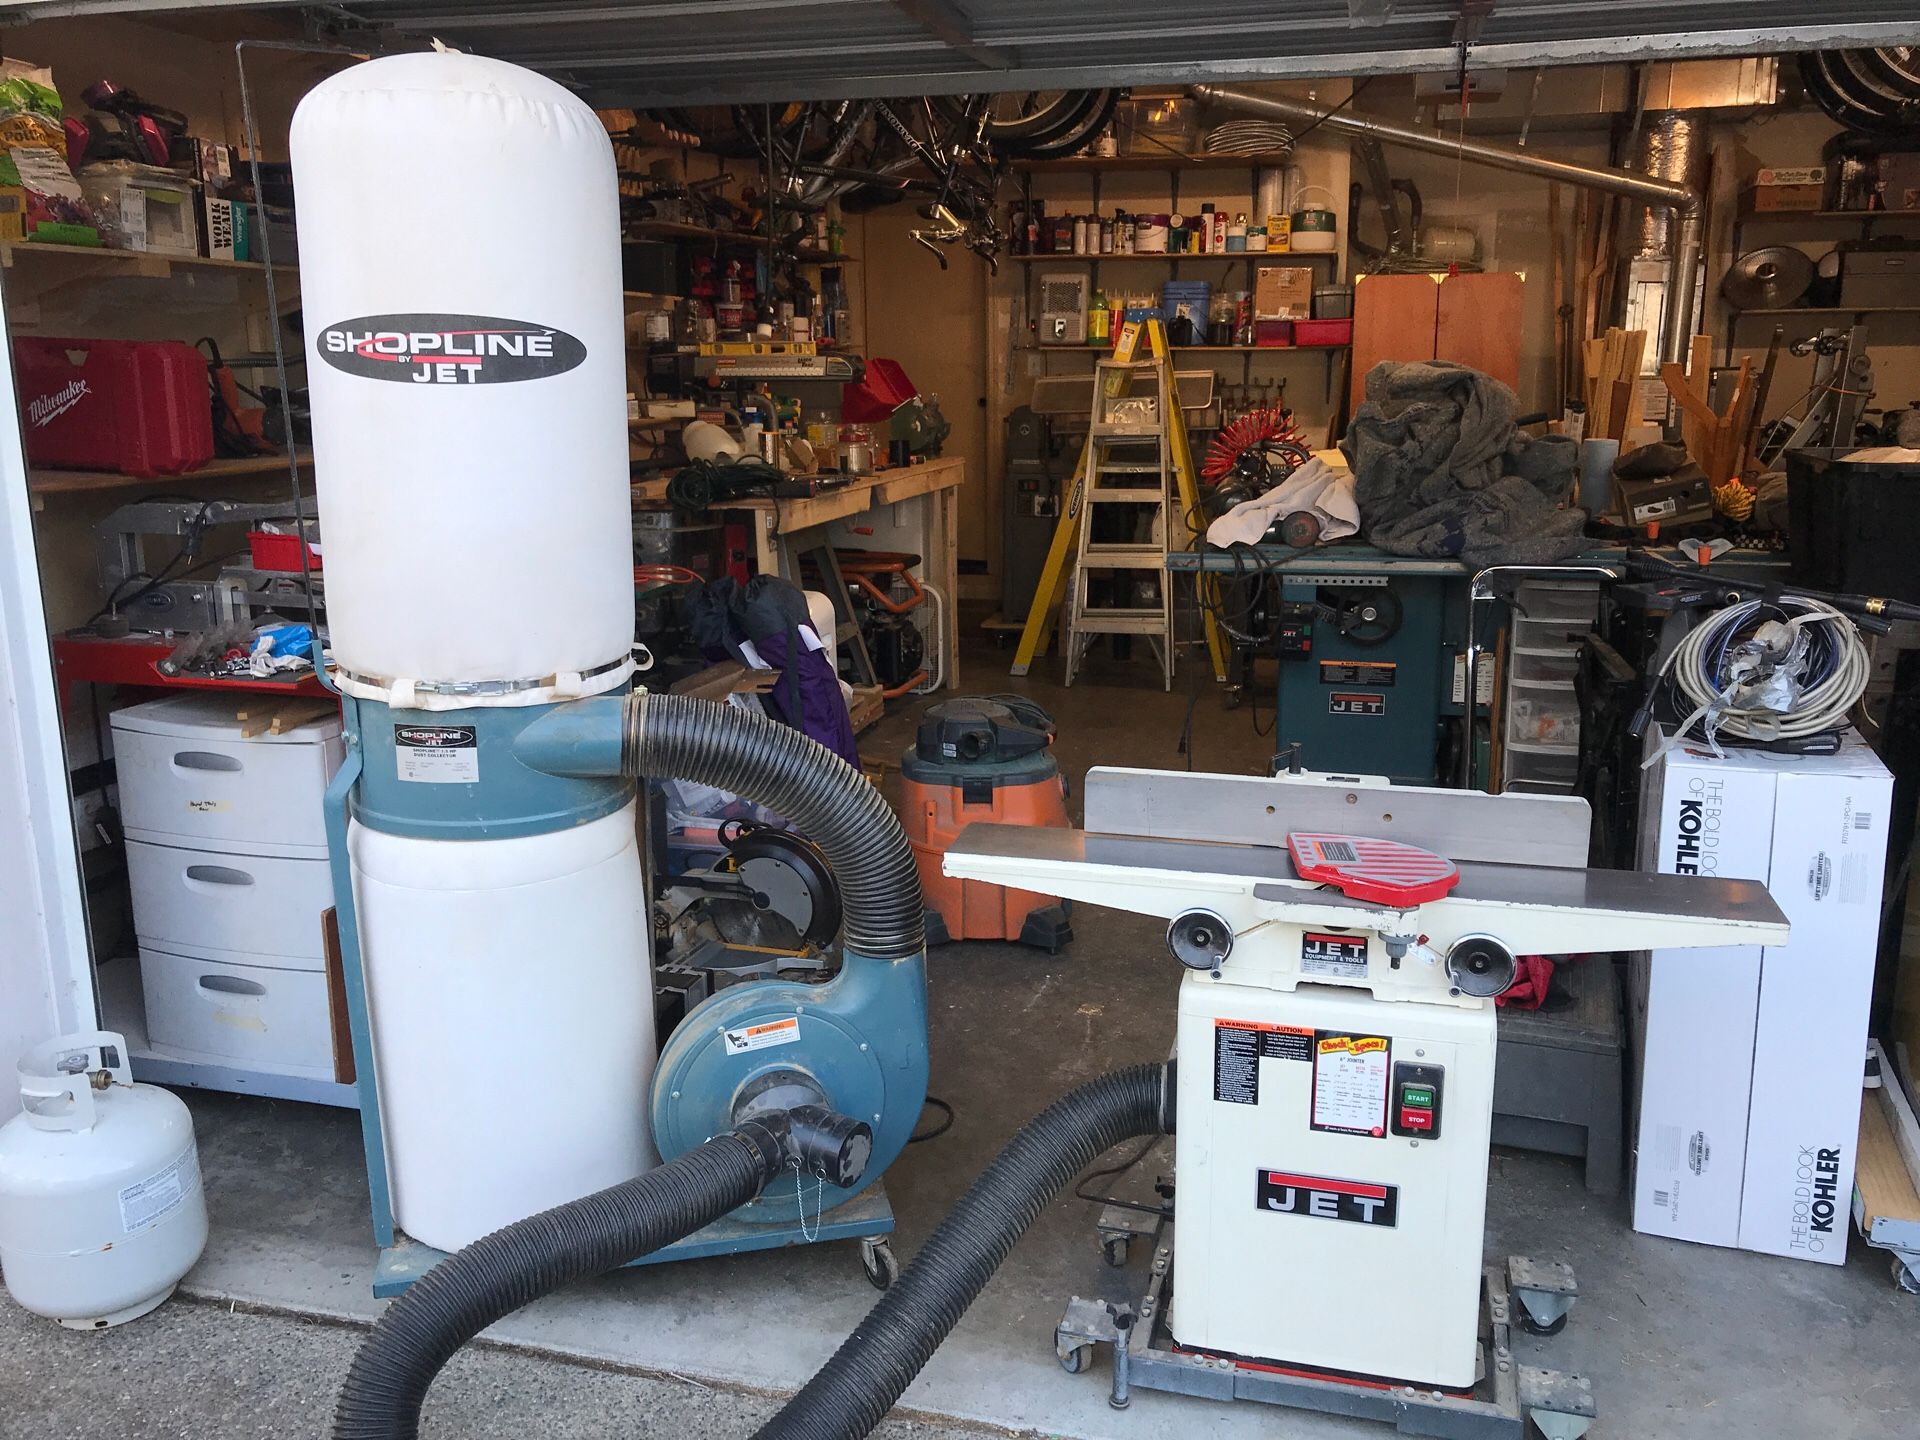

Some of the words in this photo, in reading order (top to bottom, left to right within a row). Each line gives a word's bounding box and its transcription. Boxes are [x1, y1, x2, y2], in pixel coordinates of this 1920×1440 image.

[211, 202, 223, 248] WORK
[221, 205, 232, 248] WEAR
[236, 207, 245, 243] Wrangler
[326, 330, 553, 357] SHOPLINE
[398, 355, 411, 363] BY
[412, 363, 482, 383] JET
[28, 379, 92, 423] Milwaukee
[1333, 701, 1381, 712] JET
[401, 731, 461, 739] SHOPLINE
[1688, 777, 1705, 798] OF
[1706, 779, 1724, 805] THE
[1676, 800, 1703, 875] KOHLE
[1703, 808, 1722, 848] BOLD
[1701, 851, 1719, 878] LOO
[1814, 876, 1822, 901] LIFETIME
[1305, 953, 1337, 961] EQUIPMENT
[1306, 941, 1365, 957] JET
[1225, 1021, 1258, 1029] WARNING
[1321, 1039, 1347, 1051] Check
[1354, 1040, 1385, 1052] Specs!
[1407, 1094, 1429, 1102] START
[1796, 1144, 1816, 1184] LOOK
[1810, 1148, 1841, 1233] KOHLER
[1268, 1187, 1385, 1222] JET
[1792, 1186, 1811, 1224] BOLD
[1790, 1225, 1808, 1249] THE
[1808, 1233, 1824, 1253] OF
